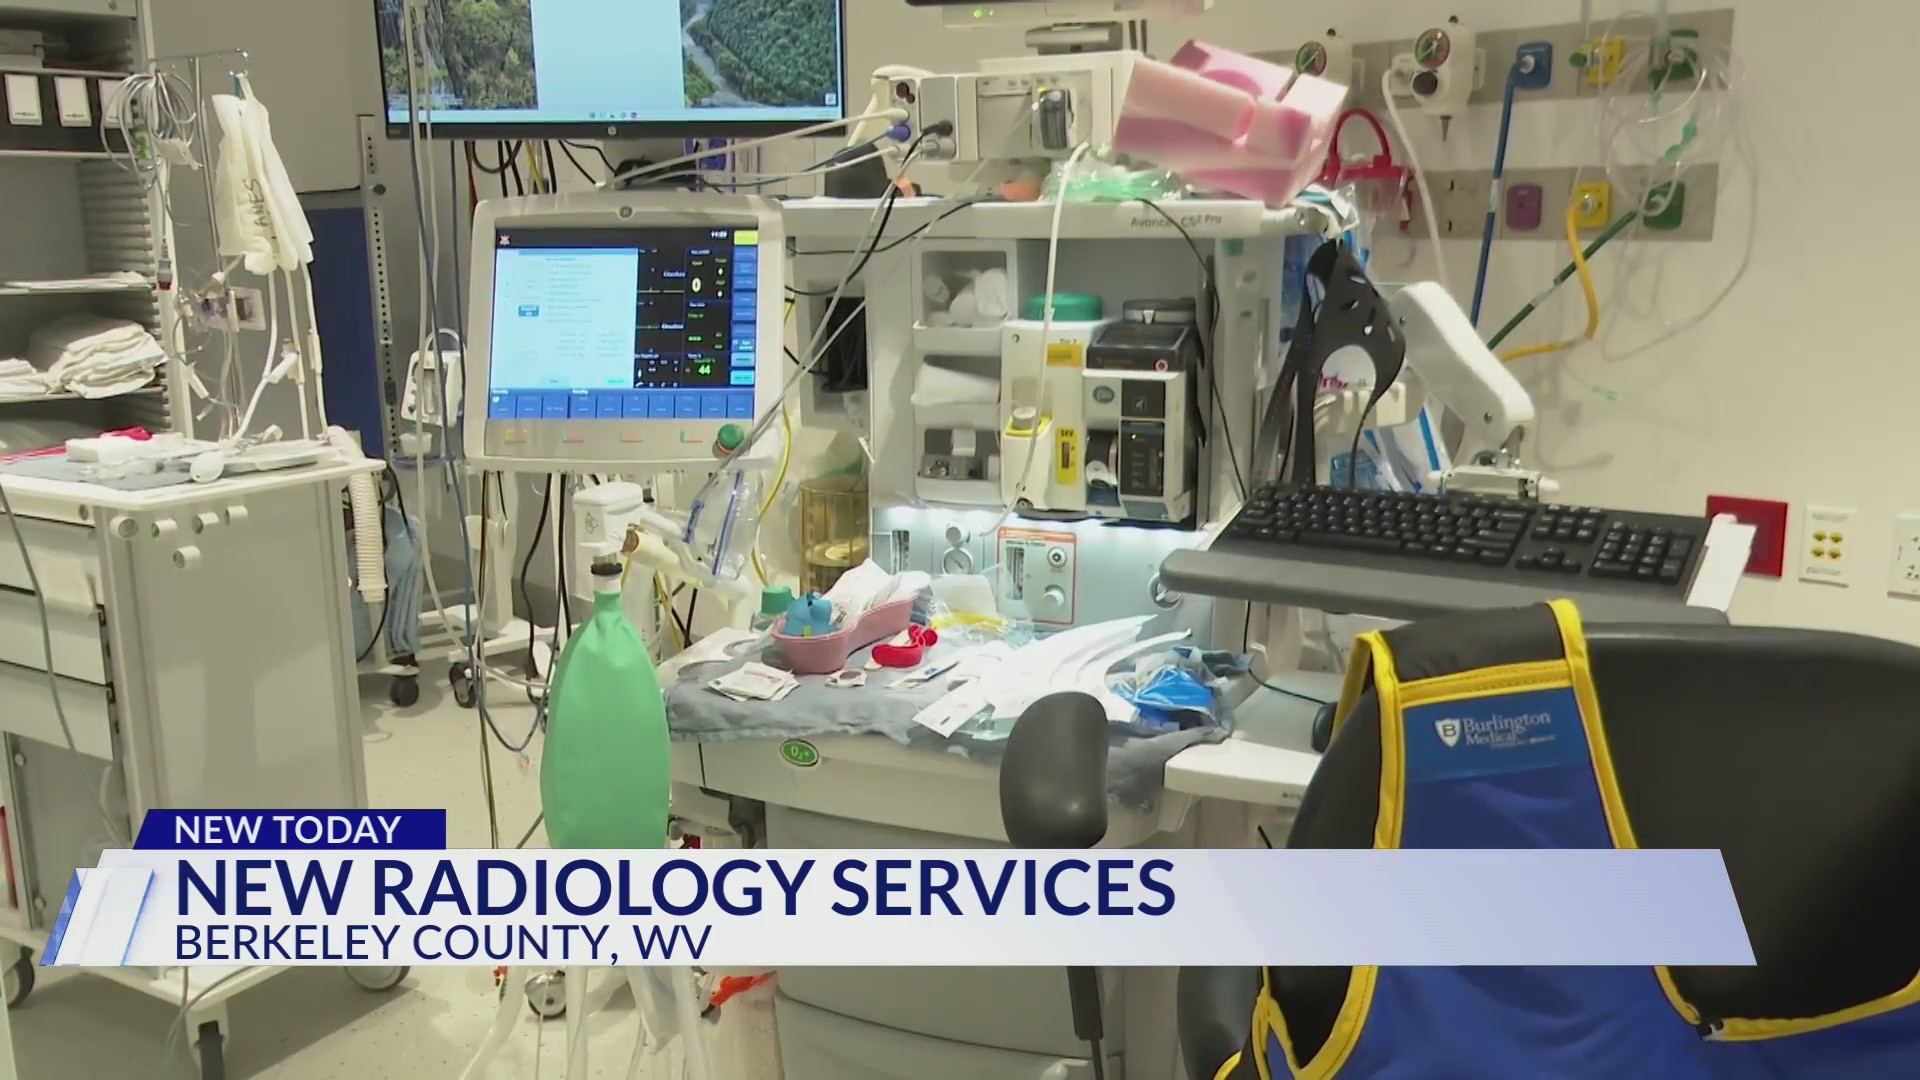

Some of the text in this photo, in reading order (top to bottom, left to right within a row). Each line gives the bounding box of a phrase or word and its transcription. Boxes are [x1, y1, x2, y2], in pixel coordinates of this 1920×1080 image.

[1204, 213, 1223, 224] Pro
[1462, 712, 1552, 734] Burlington
[1465, 732, 1517, 746] Medical
